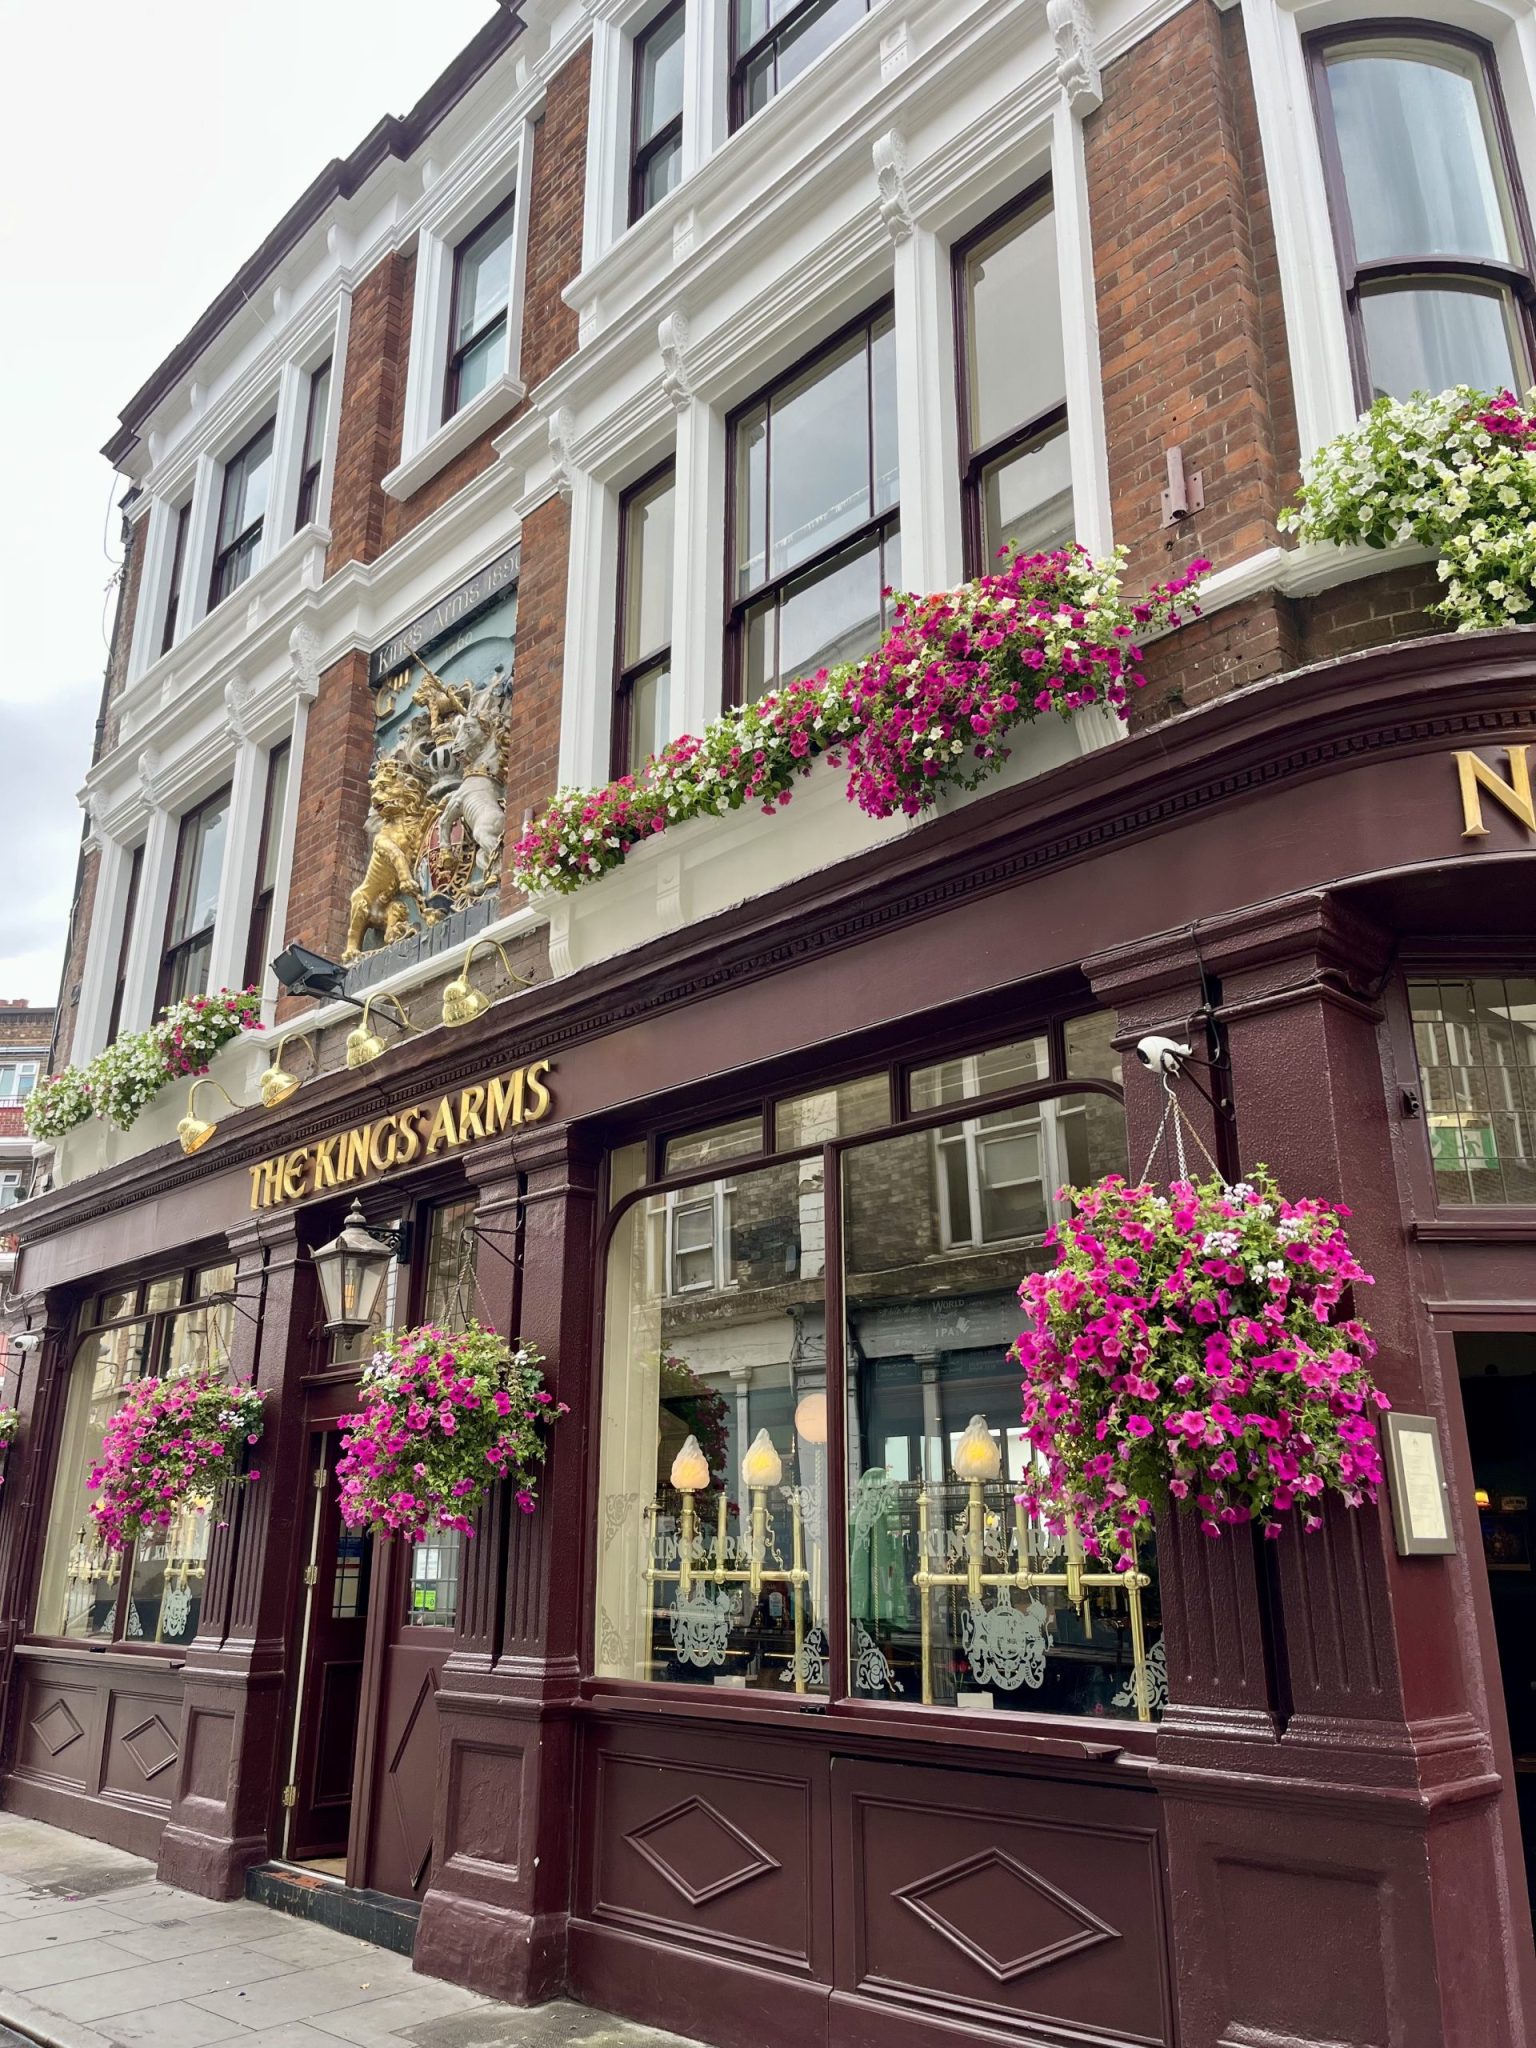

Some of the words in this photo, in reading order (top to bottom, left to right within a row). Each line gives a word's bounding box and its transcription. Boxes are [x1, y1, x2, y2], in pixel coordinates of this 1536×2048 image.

[430, 582, 480, 636] Arms
[249, 1147, 309, 1211] THE
[312, 1106, 421, 1192] KINGS
[425, 1059, 551, 1156] ARMS
[646, 1536, 705, 1563] KINGS
[707, 1536, 767, 1562] ARMS
